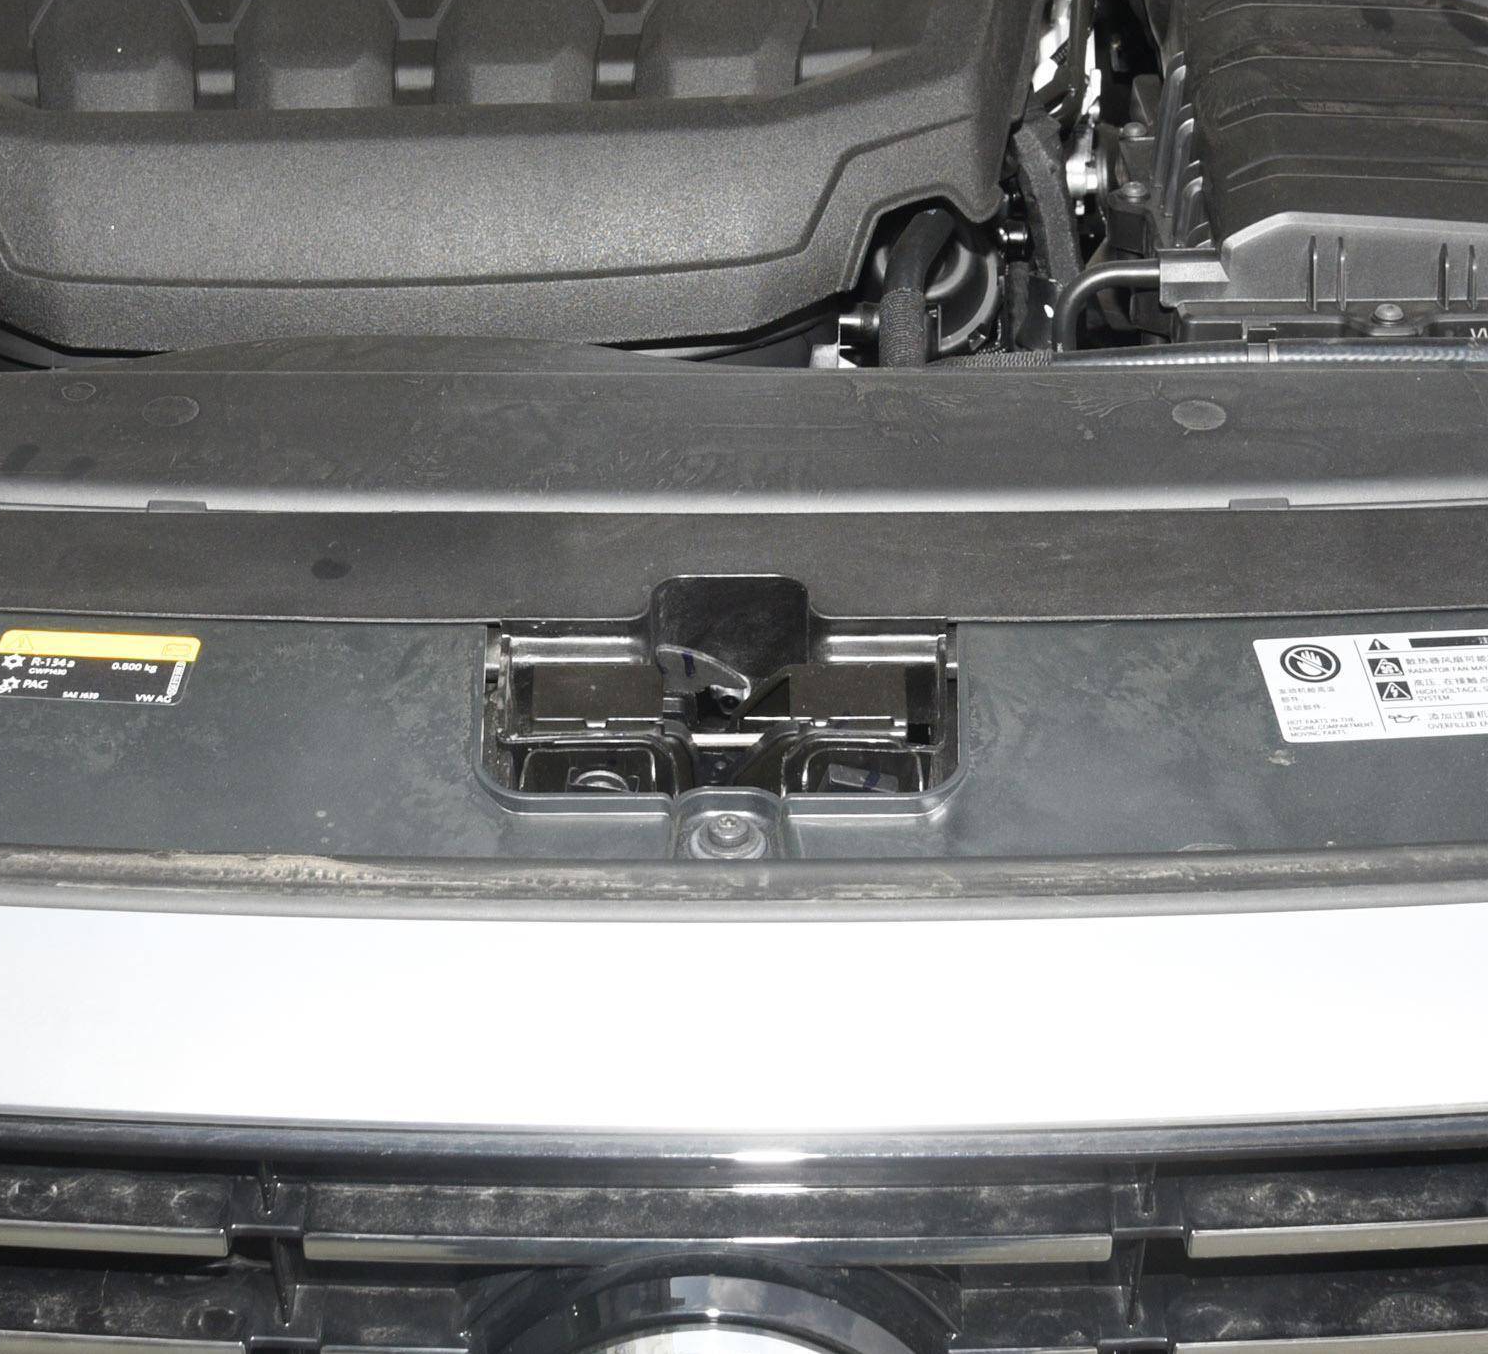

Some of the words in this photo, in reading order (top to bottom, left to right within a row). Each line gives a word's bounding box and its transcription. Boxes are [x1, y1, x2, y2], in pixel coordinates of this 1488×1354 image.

[1452, 665, 1470, 673] FAN
[22, 679, 48, 689] PAG
[135, 694, 155, 702] VW
[155, 695, 172, 703] AG
